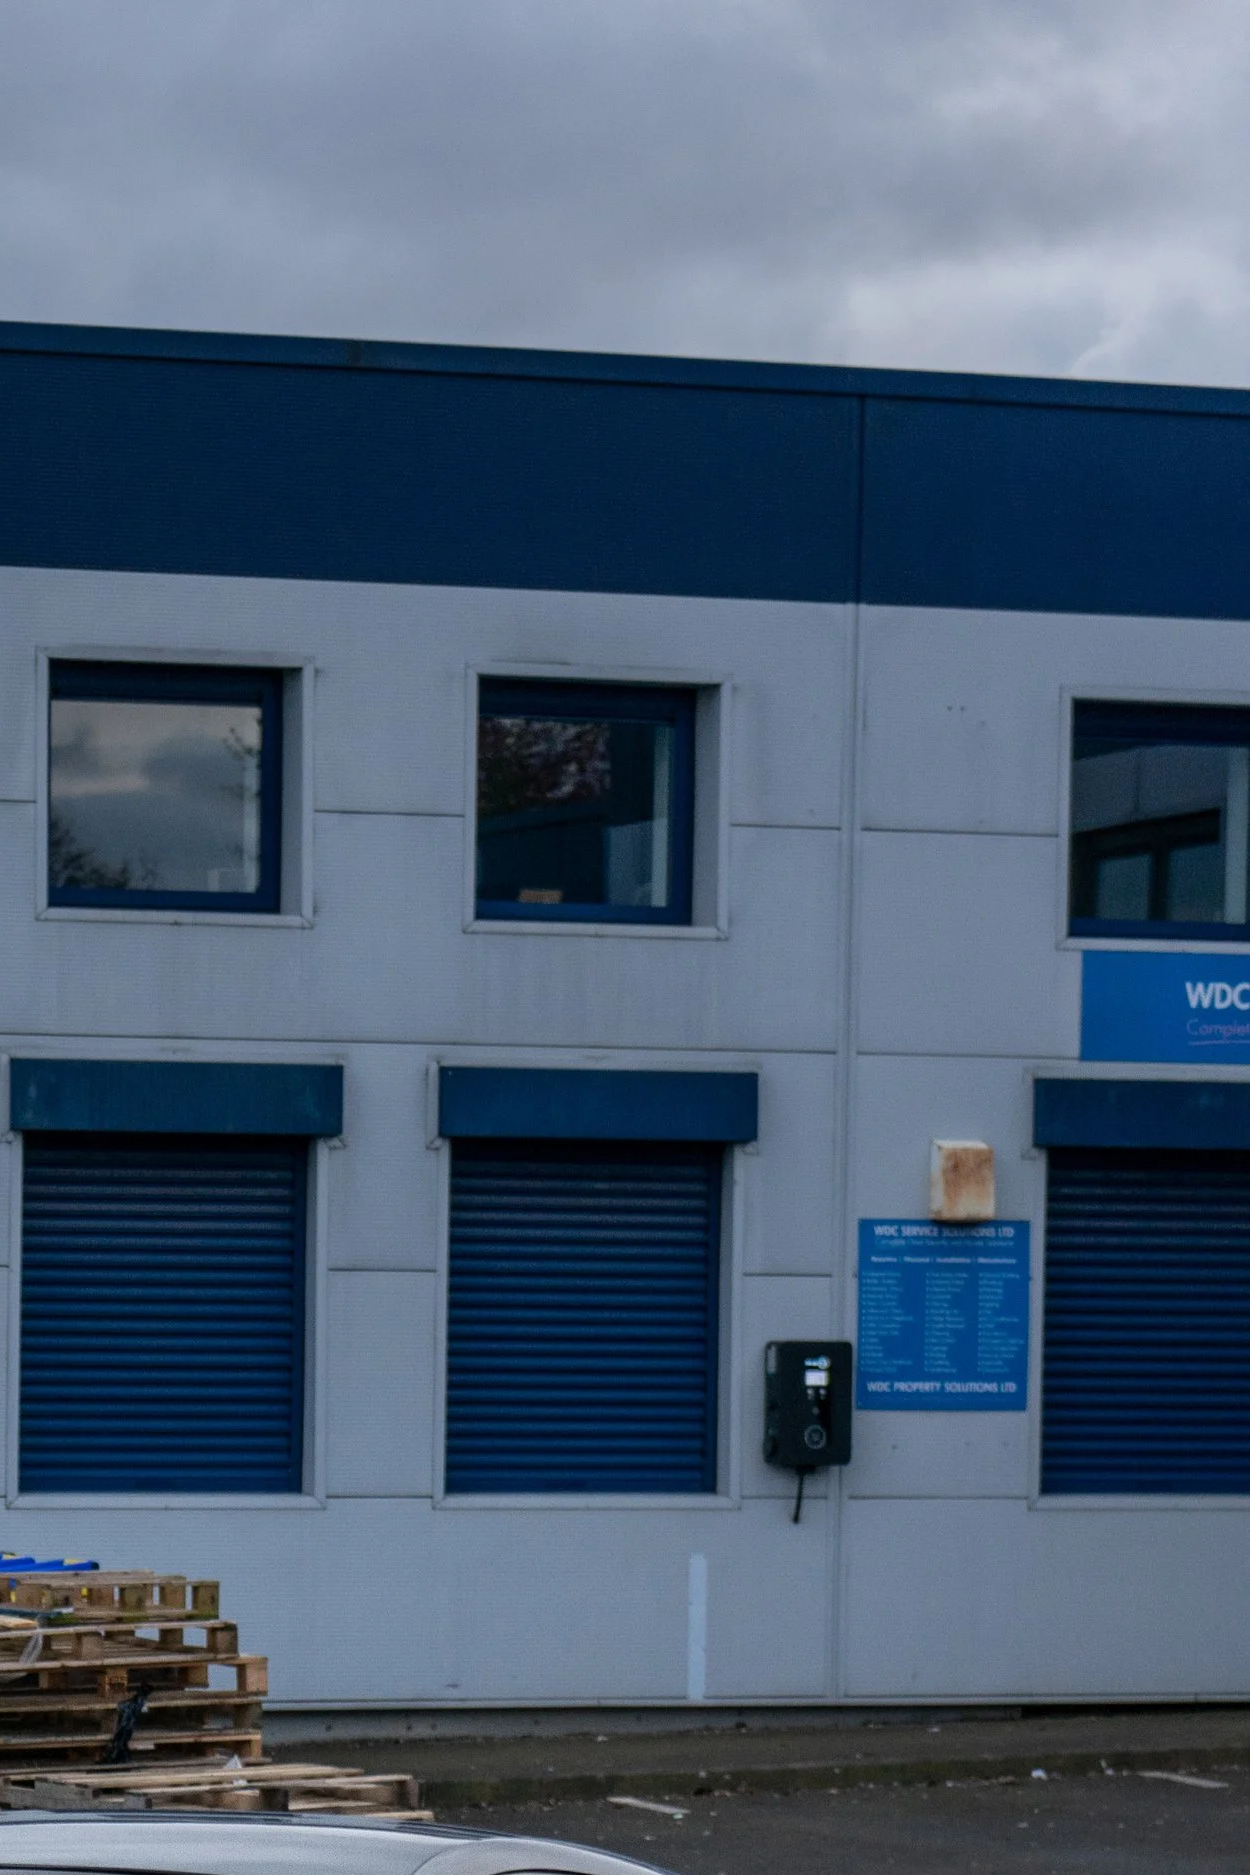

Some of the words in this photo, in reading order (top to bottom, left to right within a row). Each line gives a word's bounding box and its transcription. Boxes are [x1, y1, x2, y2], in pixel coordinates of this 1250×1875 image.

[1185, 981, 1250, 1011] WDC
[893, 1381, 941, 1393] PROPERTY
[944, 1381, 998, 1394] SOLUTIONS
